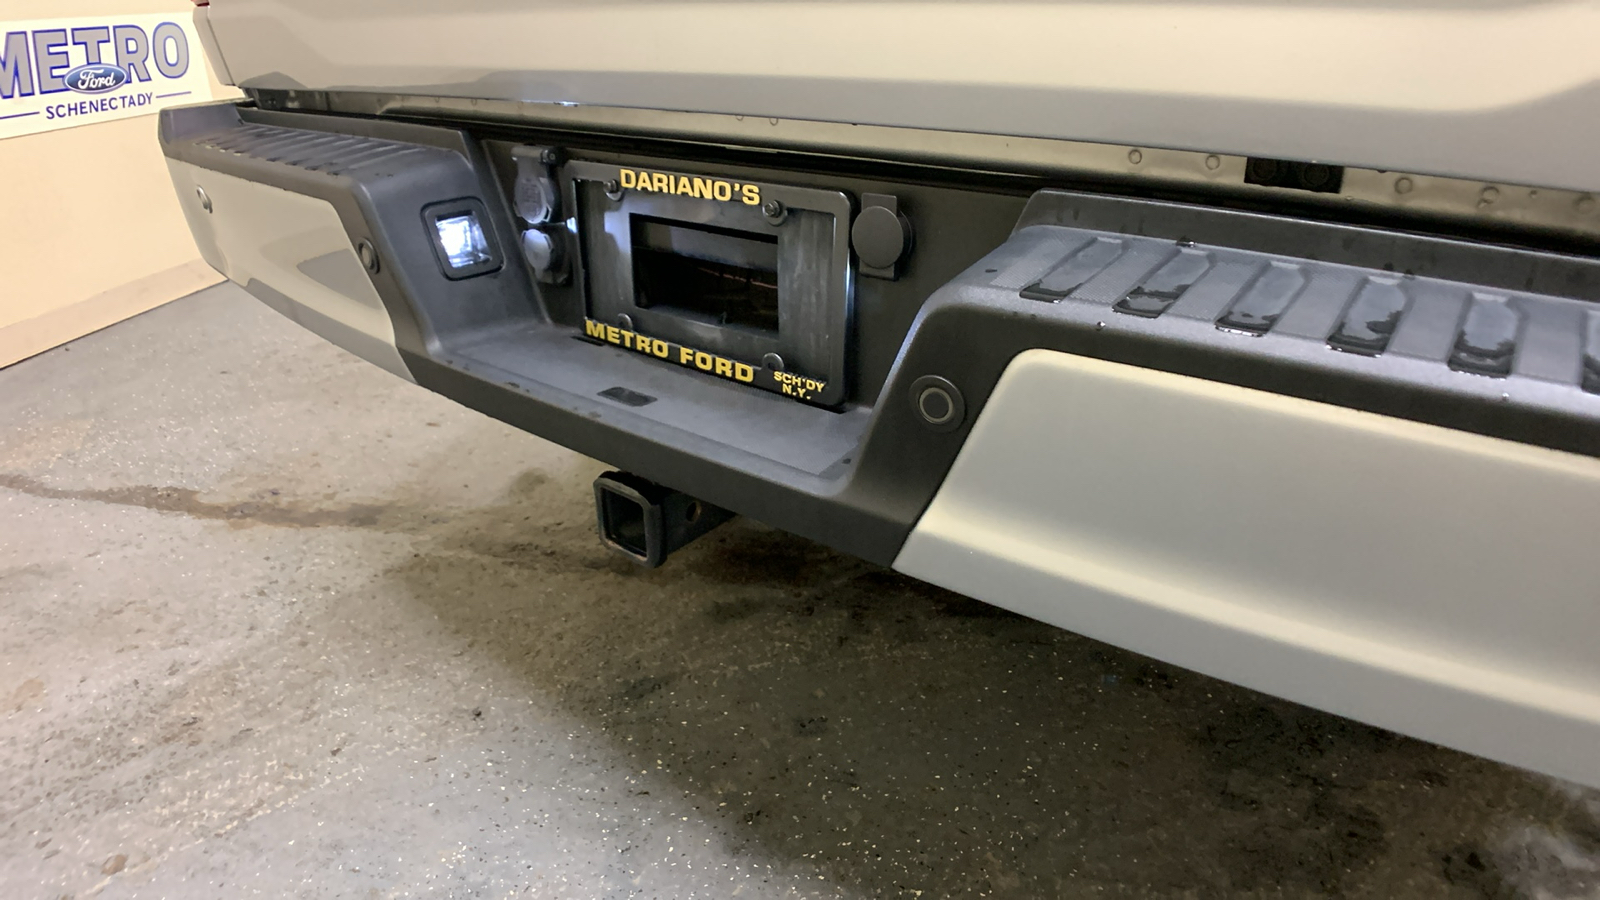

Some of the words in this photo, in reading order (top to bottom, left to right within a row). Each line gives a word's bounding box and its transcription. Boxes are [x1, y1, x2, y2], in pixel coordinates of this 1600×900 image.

[78, 69, 116, 89] Ford
[46, 93, 153, 119] SCHENECTADY
[620, 169, 760, 205] DARIANO'S
[585, 319, 669, 358] METRO
[679, 347, 754, 383] FORD
[773, 370, 825, 393] SCH'DY
[782, 383, 812, 400] N.Y.
